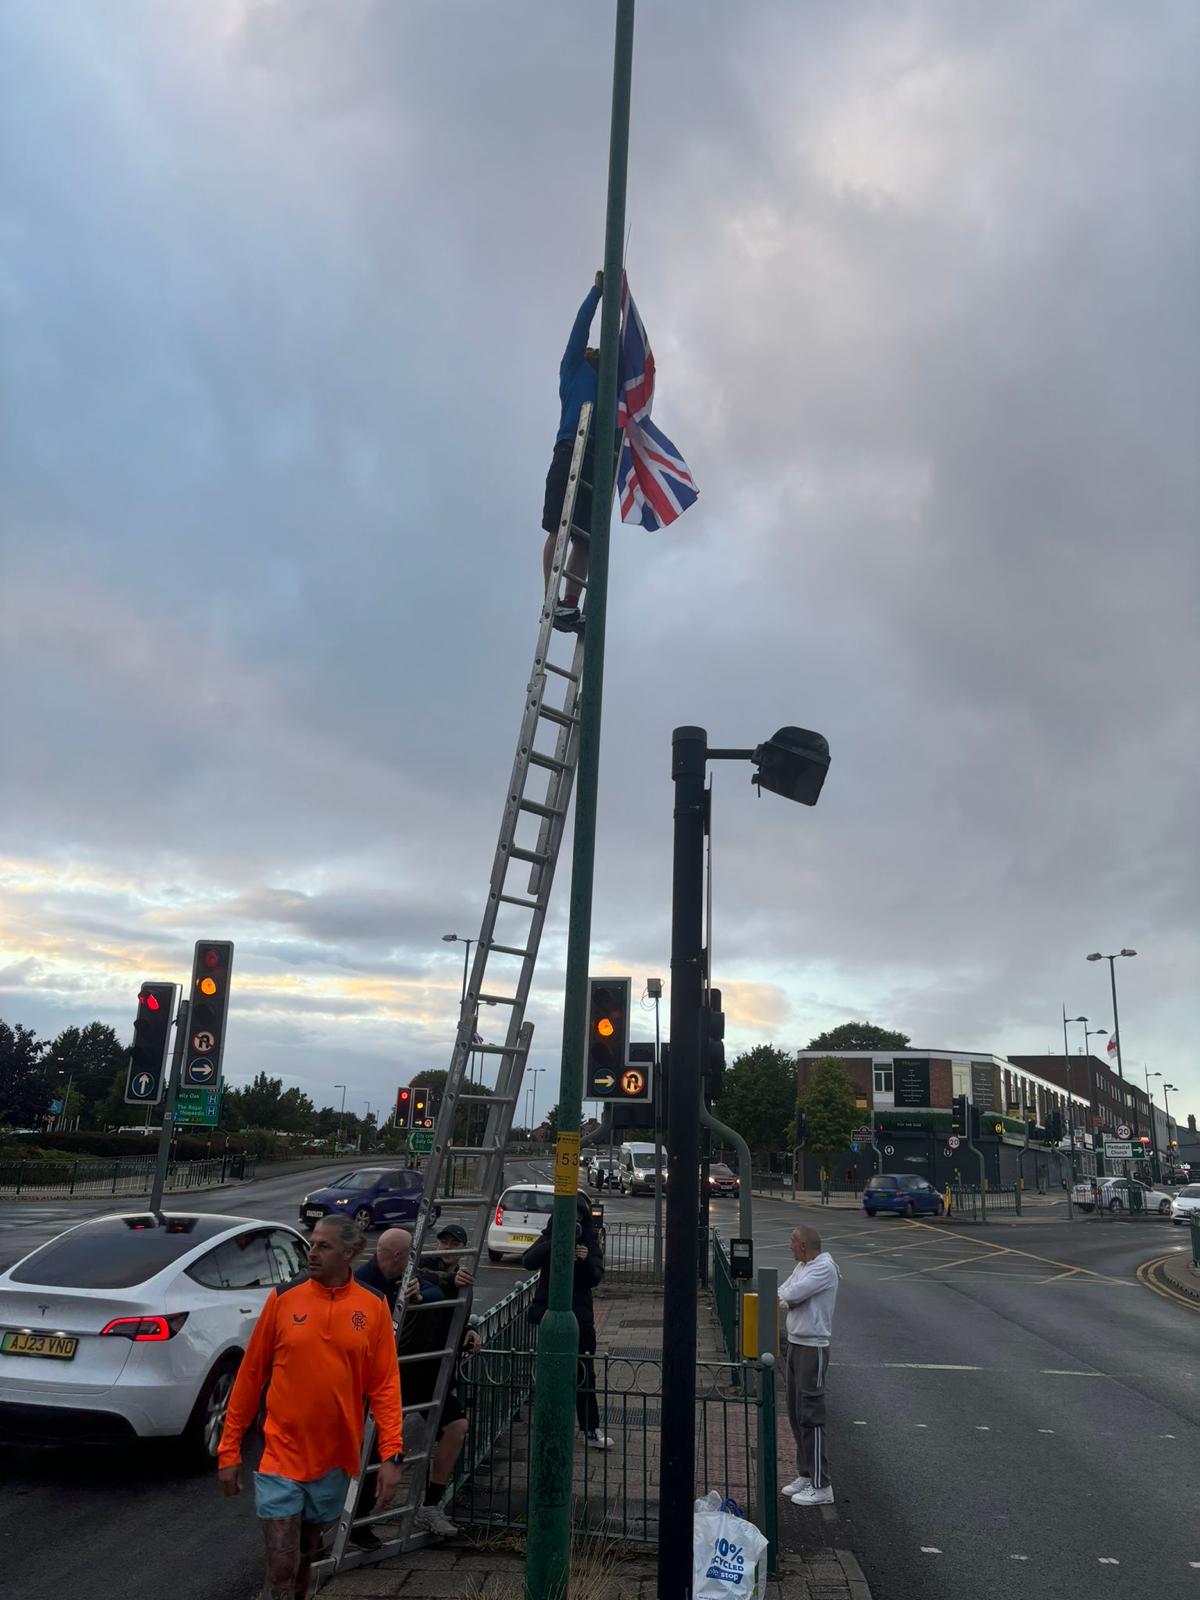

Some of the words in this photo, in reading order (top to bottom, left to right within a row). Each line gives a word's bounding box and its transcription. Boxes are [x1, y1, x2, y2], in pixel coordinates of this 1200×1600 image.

[10, 1335, 45, 1351] AJ23
[48, 1338, 74, 1354] VNO
[720, 1572, 739, 1581] stop
